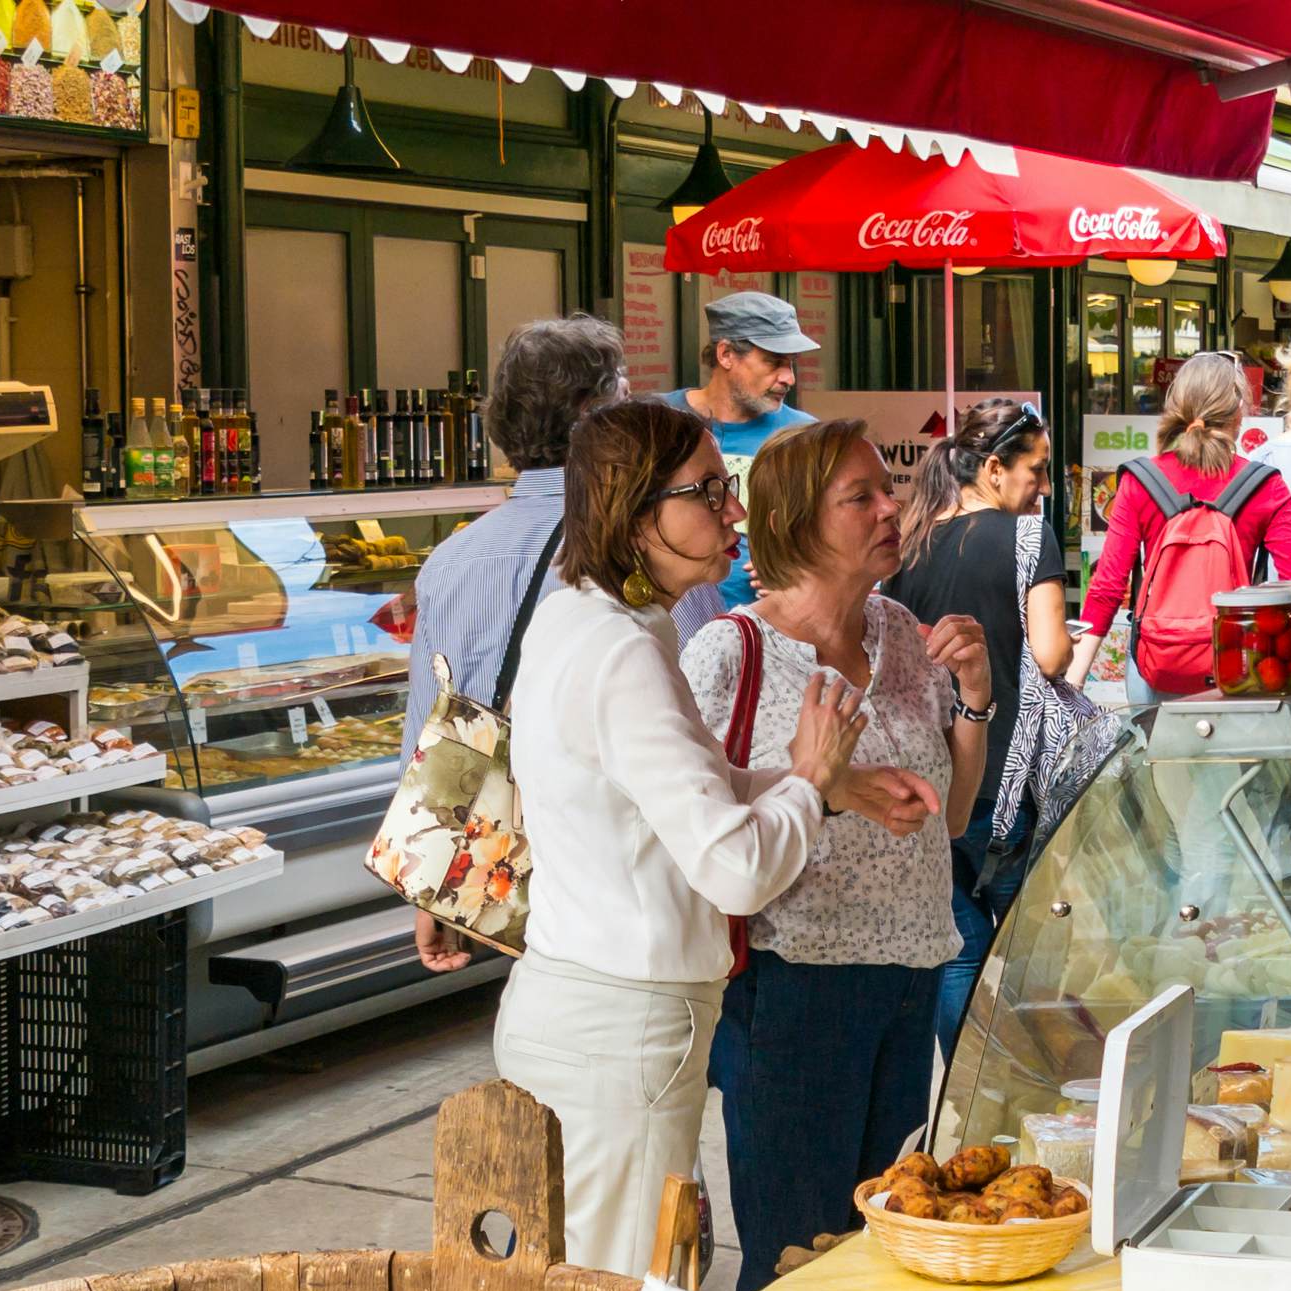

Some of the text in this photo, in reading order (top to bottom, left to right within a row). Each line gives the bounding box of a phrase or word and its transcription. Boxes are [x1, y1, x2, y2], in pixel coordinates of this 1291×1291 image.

[858, 210, 975, 250] Coca-Cola
[1069, 206, 1160, 243] Coca-Cola
[1093, 425, 1150, 450] asia
